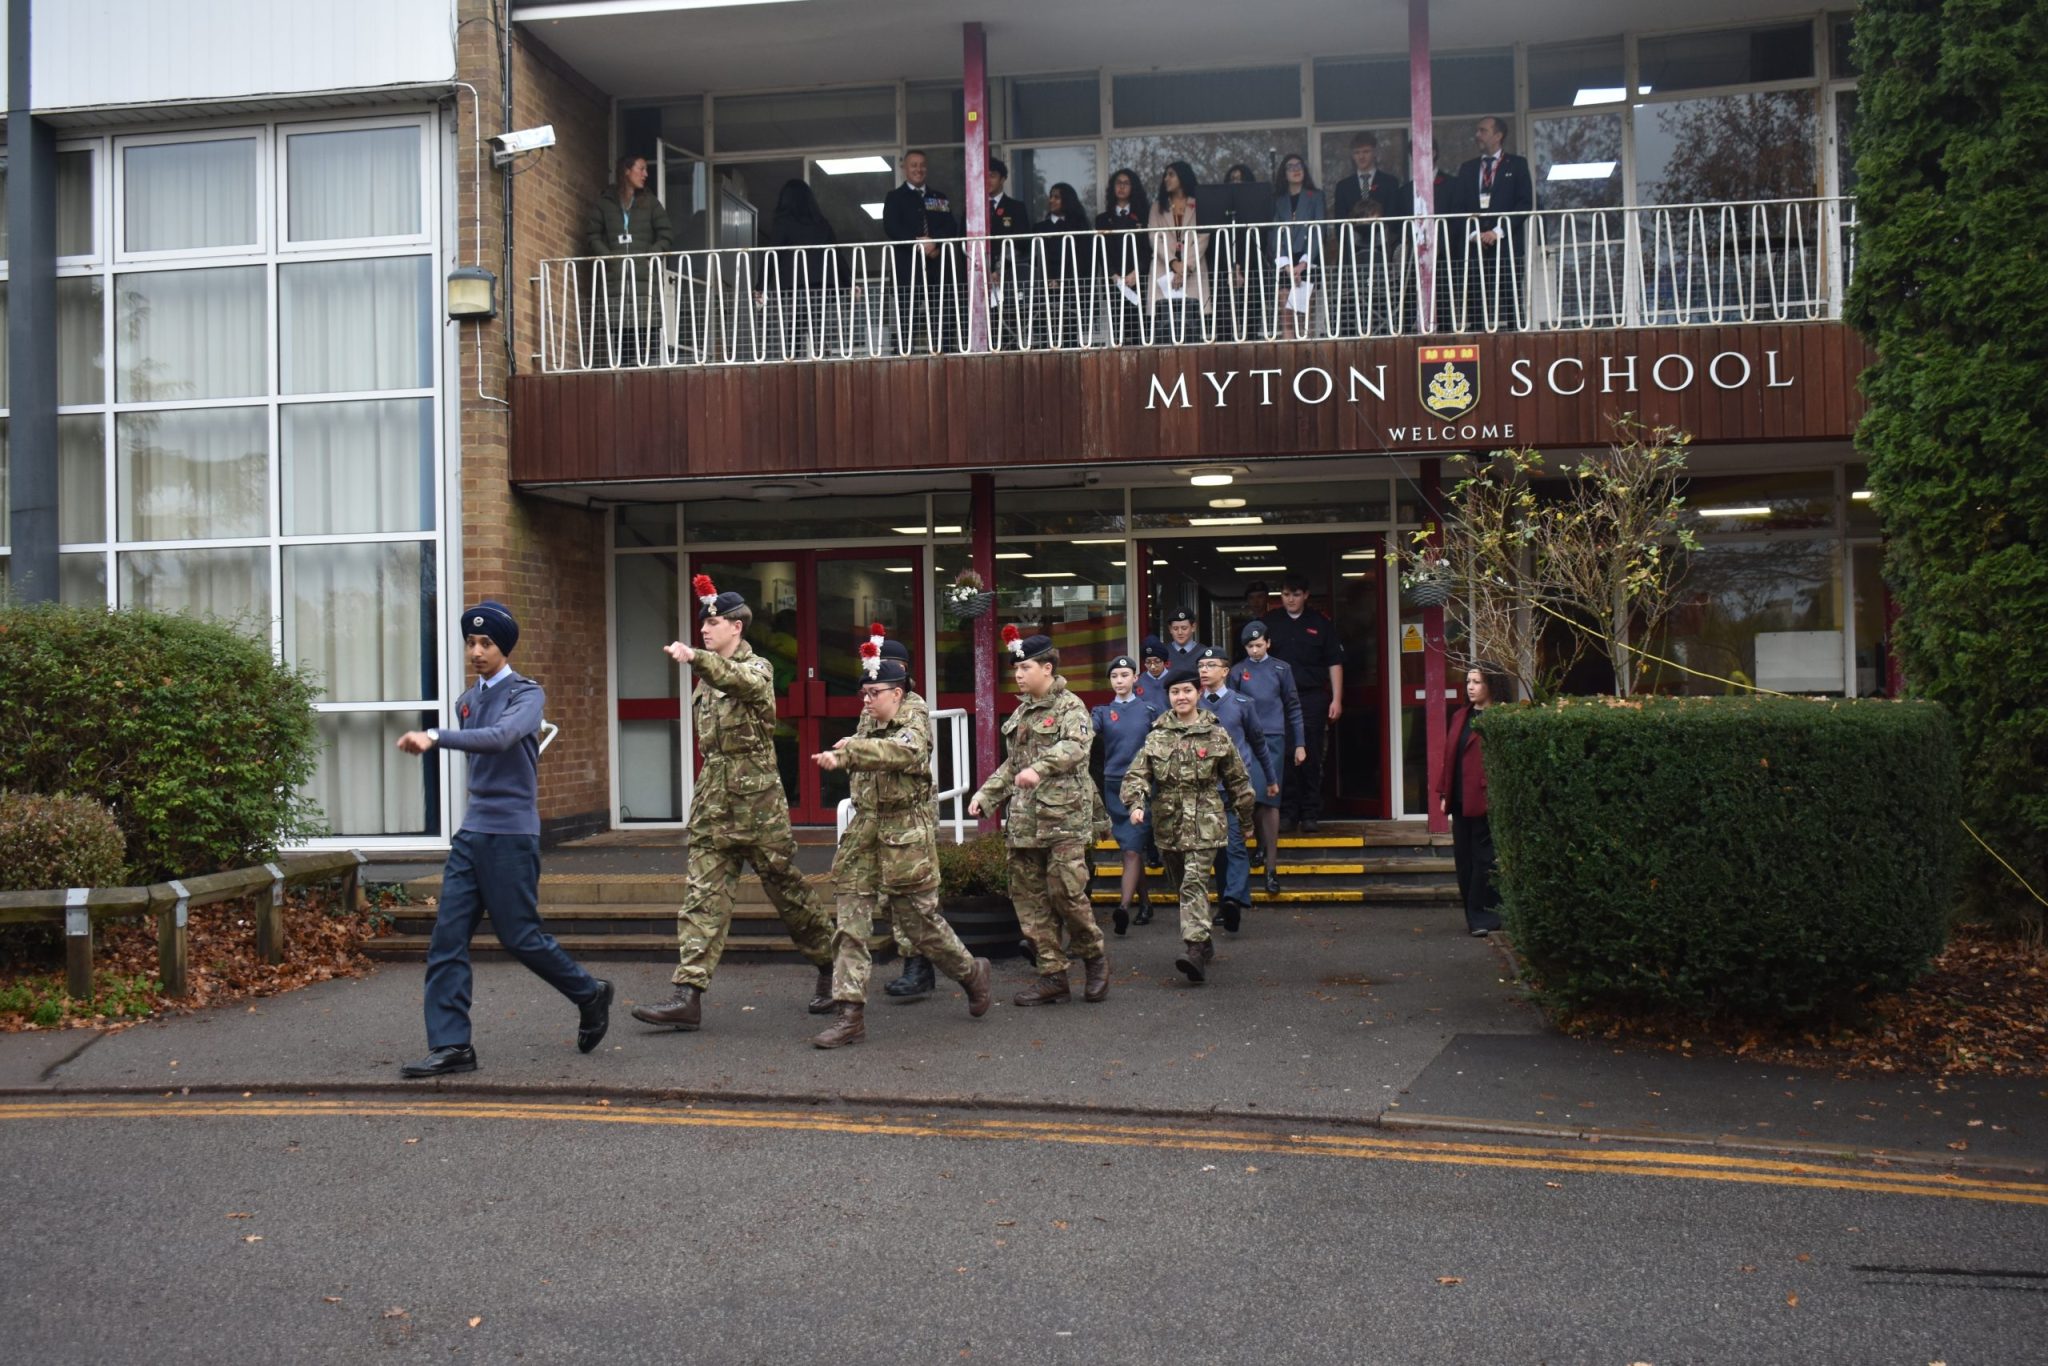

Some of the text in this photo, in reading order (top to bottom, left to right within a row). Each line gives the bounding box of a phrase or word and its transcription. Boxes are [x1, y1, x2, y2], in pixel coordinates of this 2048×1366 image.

[1145, 350, 1794, 409] MYTON SCHOOL
[1388, 424, 1514, 441] WELCOME
